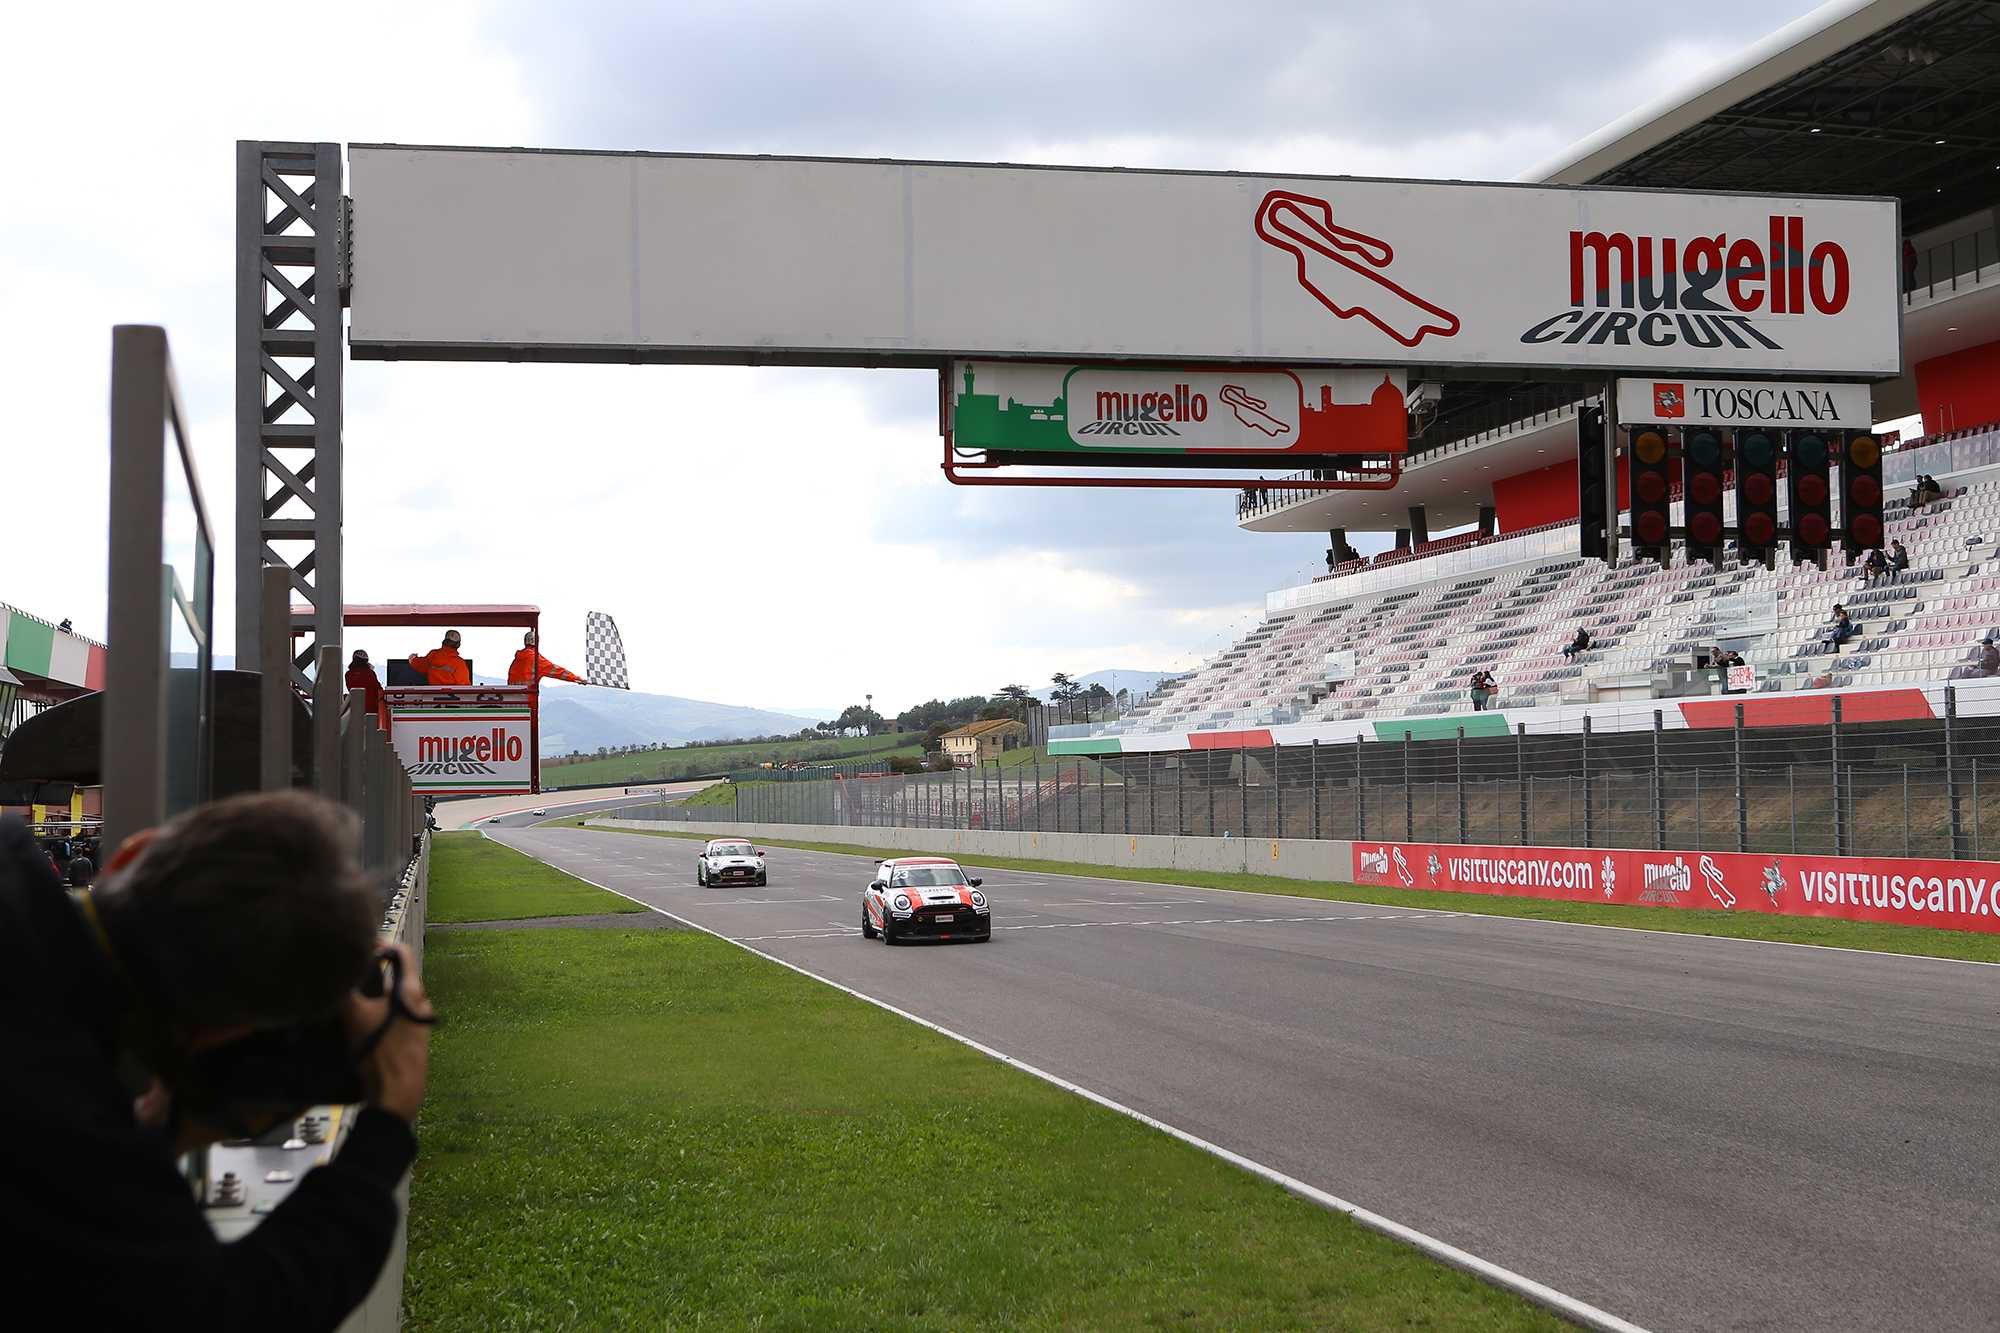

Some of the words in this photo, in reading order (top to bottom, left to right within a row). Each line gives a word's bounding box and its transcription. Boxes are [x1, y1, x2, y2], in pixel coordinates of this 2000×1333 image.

[1569, 215, 1850, 316] mugello
[1519, 310, 1785, 351] CIRCUIT
[1096, 383, 1208, 423] mugello
[1694, 387, 1841, 421] TOSCANA
[1077, 420, 1181, 436] CIRCUIT
[418, 727, 522, 763] mugello
[407, 762, 497, 775] CIRCUIT
